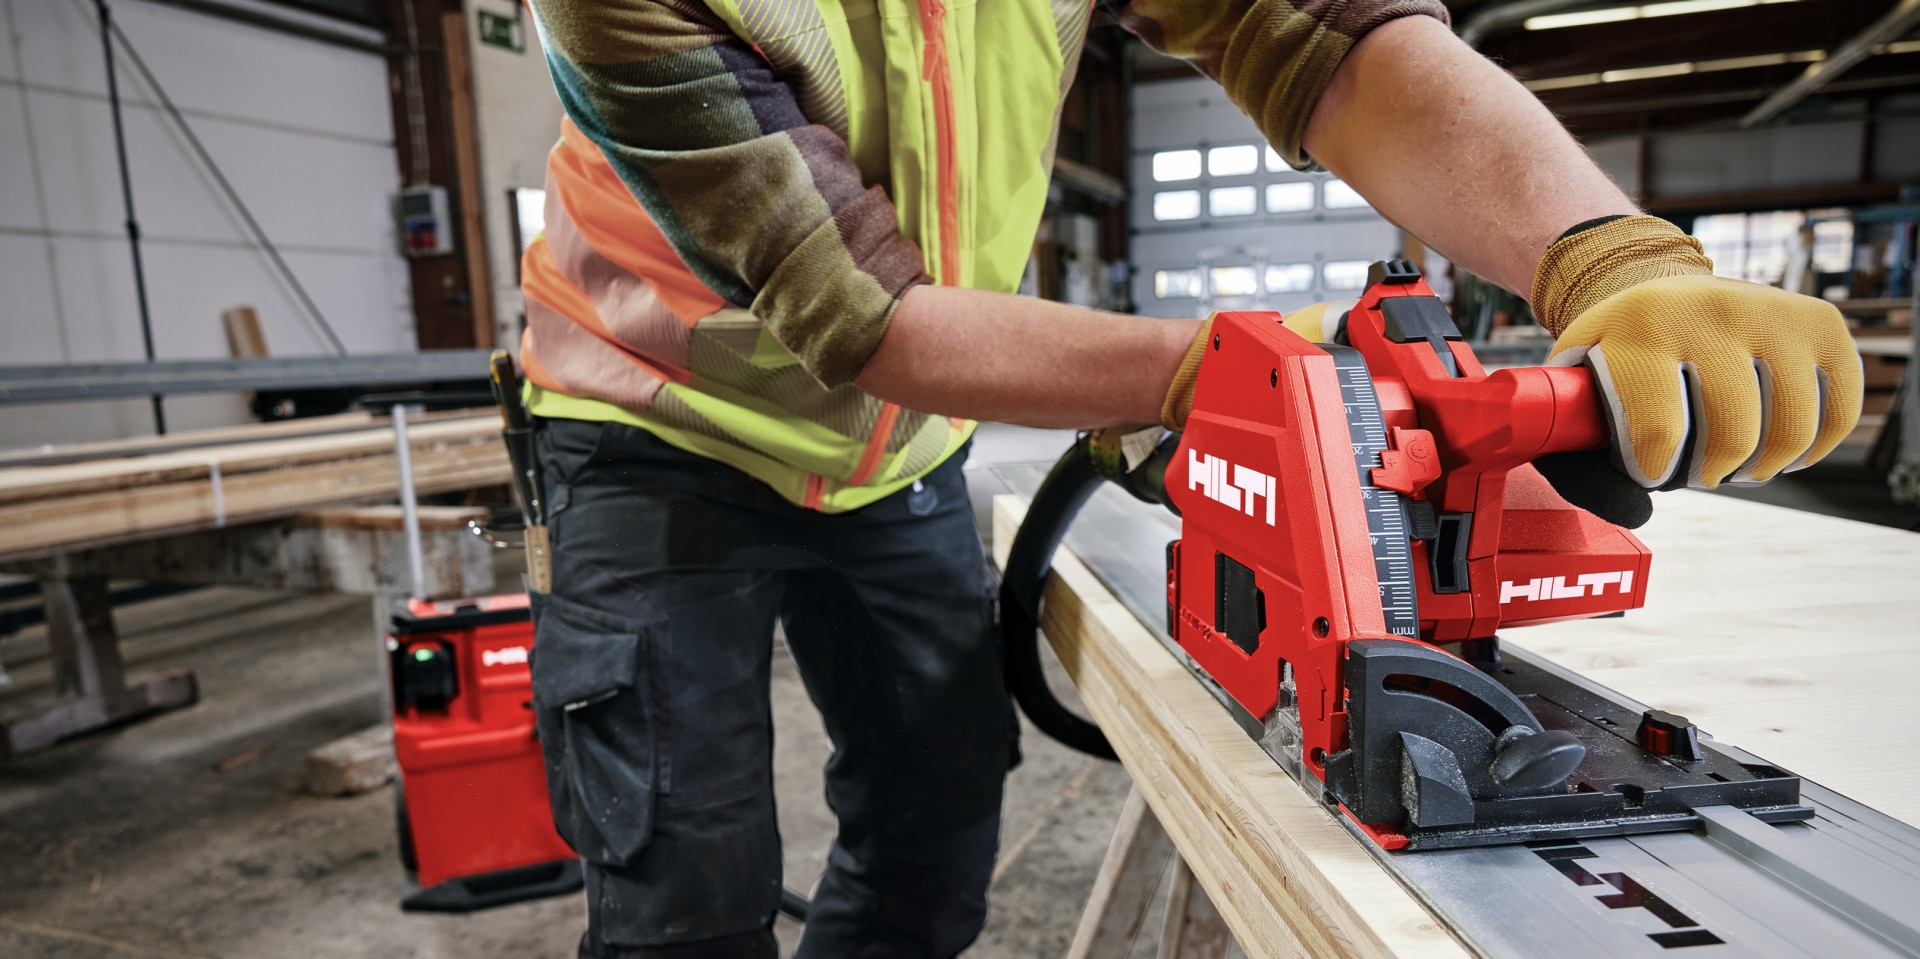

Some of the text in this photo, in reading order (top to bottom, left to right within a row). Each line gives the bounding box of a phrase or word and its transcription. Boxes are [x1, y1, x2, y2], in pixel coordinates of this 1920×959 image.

[1188, 448, 1277, 527] HILTI
[1499, 570, 1633, 604] HILTI
[1392, 627, 1415, 635] mm
[1523, 837, 1727, 949] ILTI
